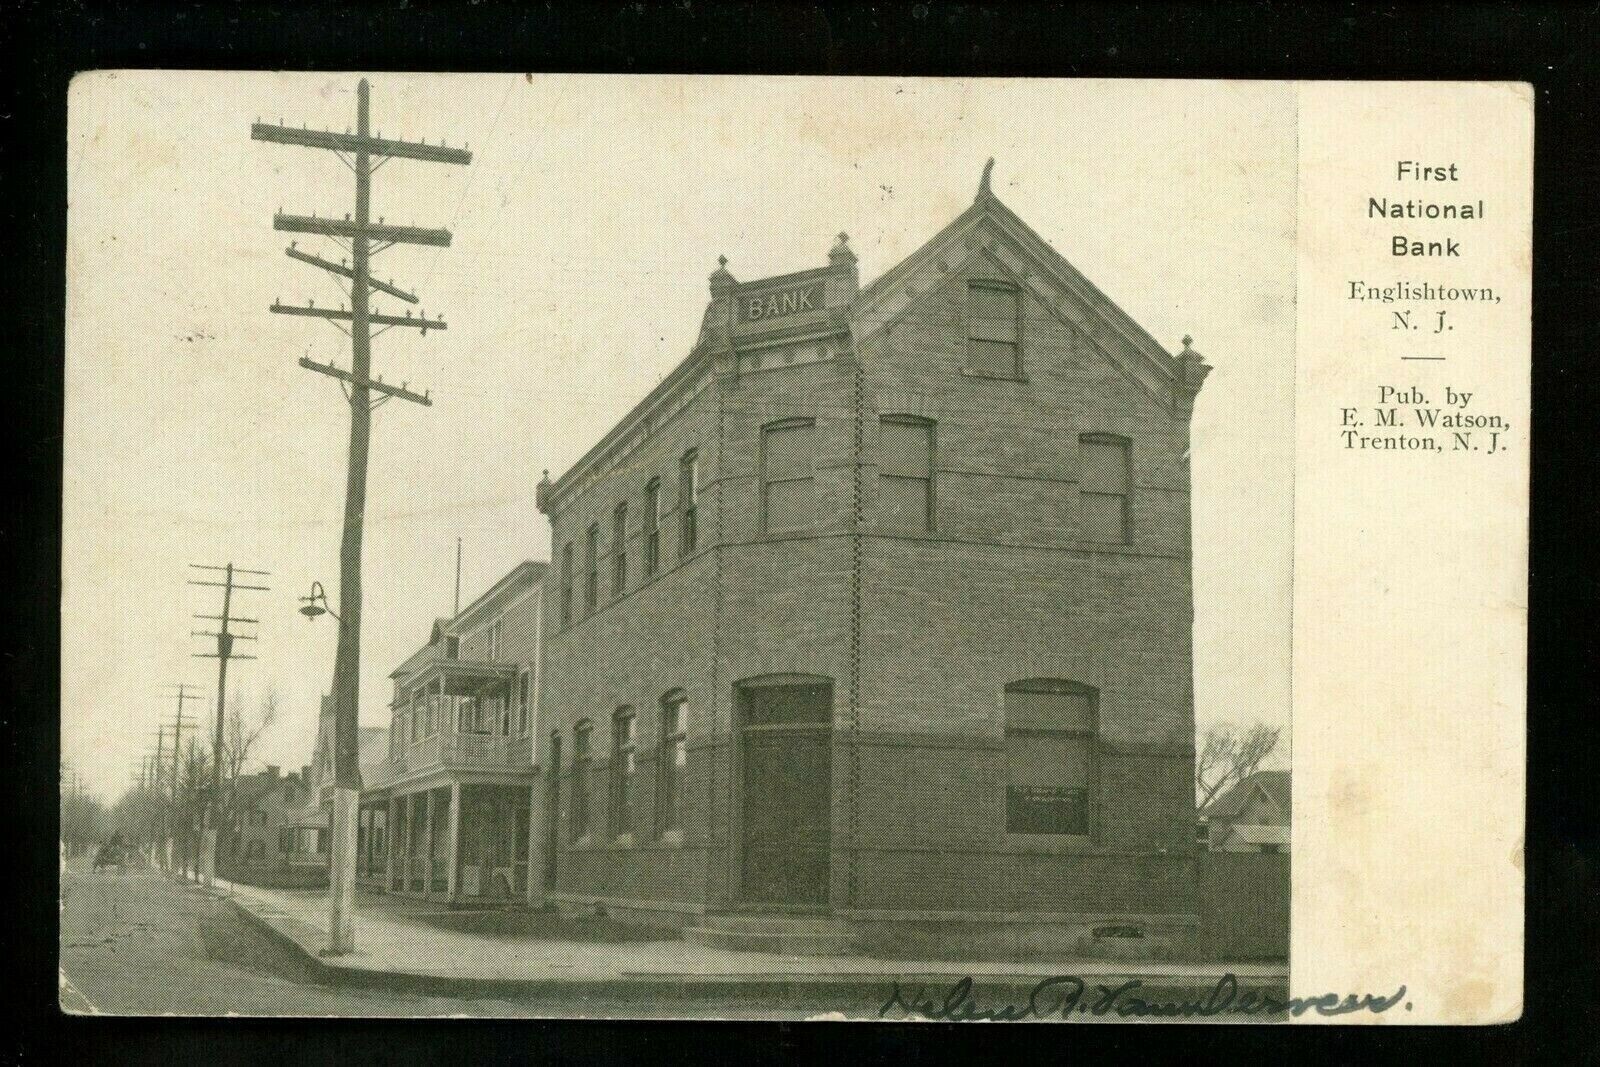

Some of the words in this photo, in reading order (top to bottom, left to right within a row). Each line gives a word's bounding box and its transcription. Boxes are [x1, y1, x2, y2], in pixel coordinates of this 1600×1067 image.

[1397, 161, 1458, 181] First
[1368, 197, 1483, 219] National
[1392, 236, 1460, 257] Bank
[750, 287, 814, 319] BANK
[1348, 280, 1501, 304] Englishtown,
[1392, 310, 1418, 330] N.
[1434, 310, 1454, 333] J.
[1378, 385, 1429, 404] Pub.
[1446, 386, 1472, 408] by
[1340, 408, 1364, 427] E.
[1374, 408, 1404, 427] M.
[1415, 408, 1510, 430] Watson,
[1341, 430, 1442, 452] Trenton,
[1452, 432, 1478, 450] N.
[1487, 432, 1507, 454] J.
